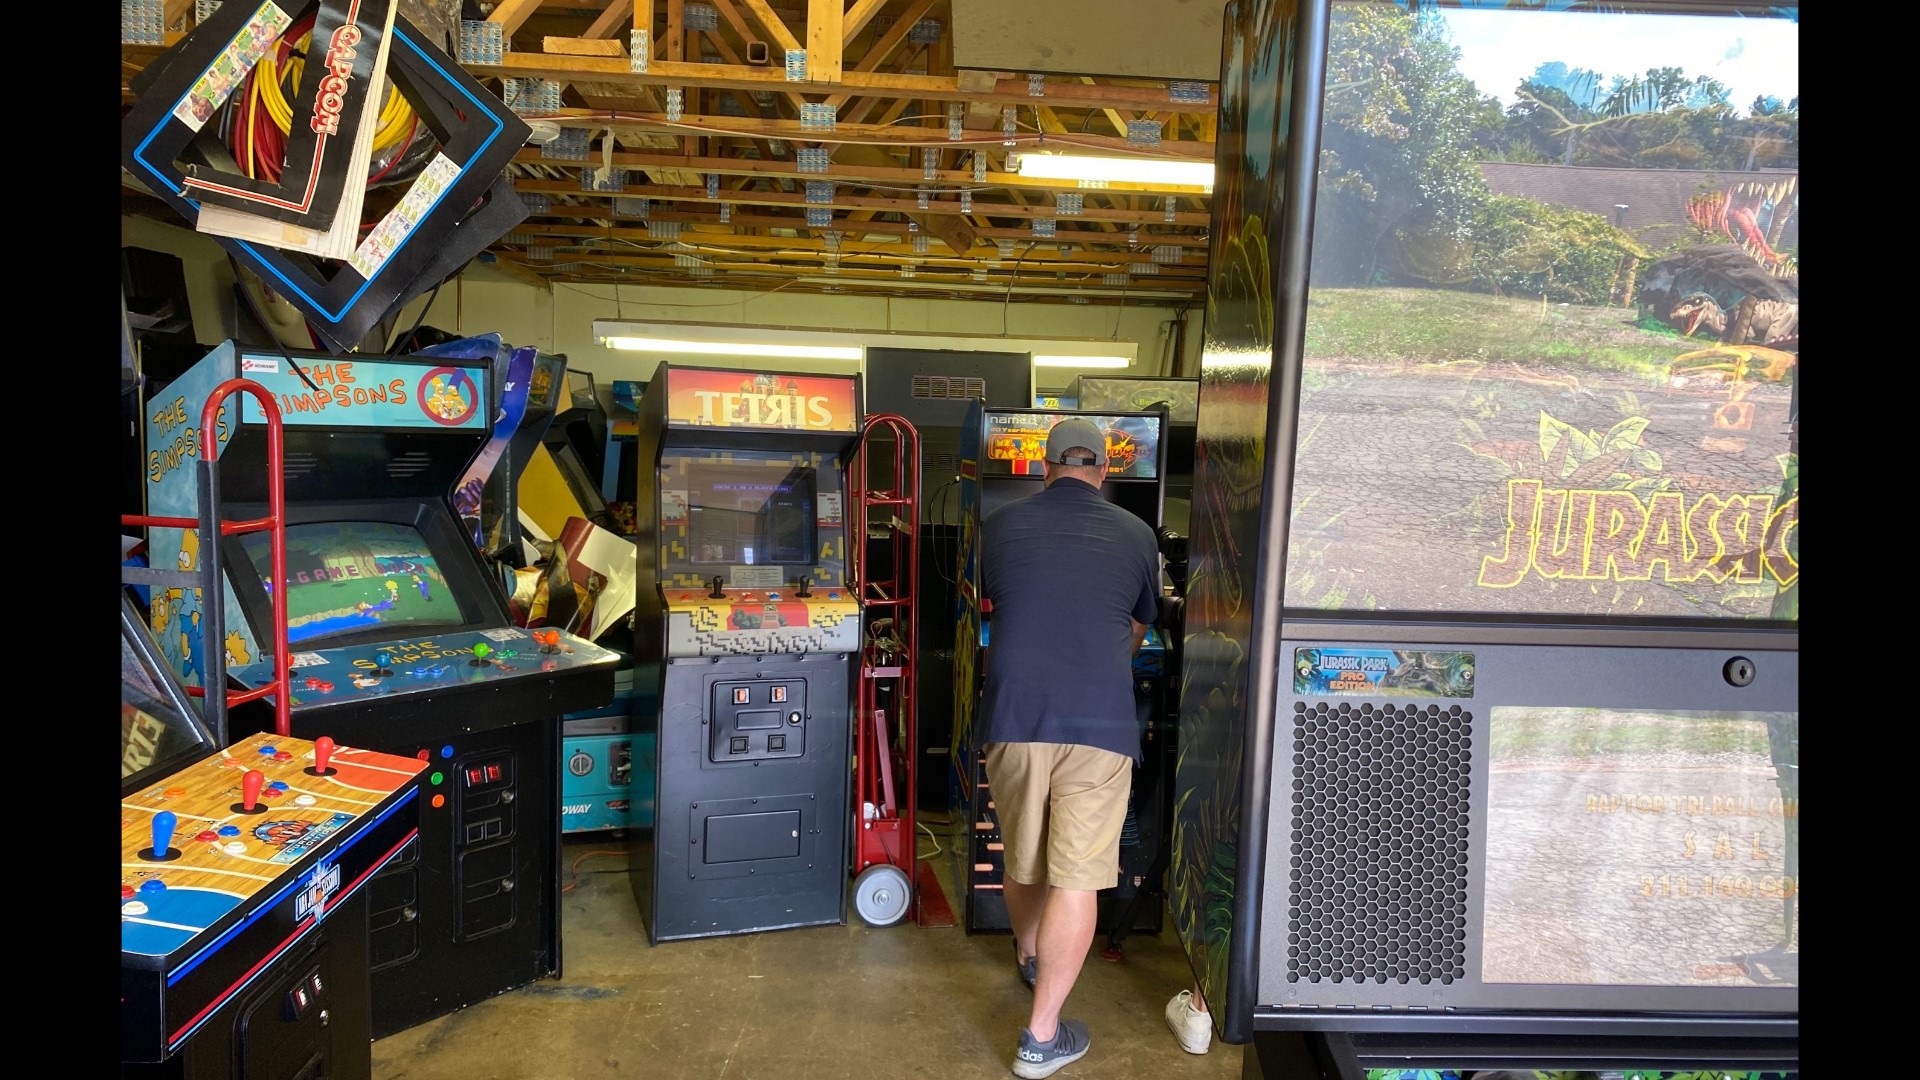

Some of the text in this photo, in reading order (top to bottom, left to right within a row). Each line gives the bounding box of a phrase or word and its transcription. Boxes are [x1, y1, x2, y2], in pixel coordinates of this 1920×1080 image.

[311, 25, 361, 135] CAPCOM
[288, 363, 356, 388] THE
[153, 396, 187, 438] THE
[149, 406, 228, 483] SIMPSS
[995, 448, 1047, 459] PAC-MA
[296, 565, 359, 583] GAME
[376, 642, 440, 653] THE
[353, 647, 494, 669] SMPSON
[1319, 656, 1389, 671] JURASSIC PARK
[1330, 681, 1376, 690] EDITION
[1341, 672, 1366, 681] PRO
[1586, 794, 1664, 815] RAPTOR
[1672, 795, 1761, 817] TRI-BALL
